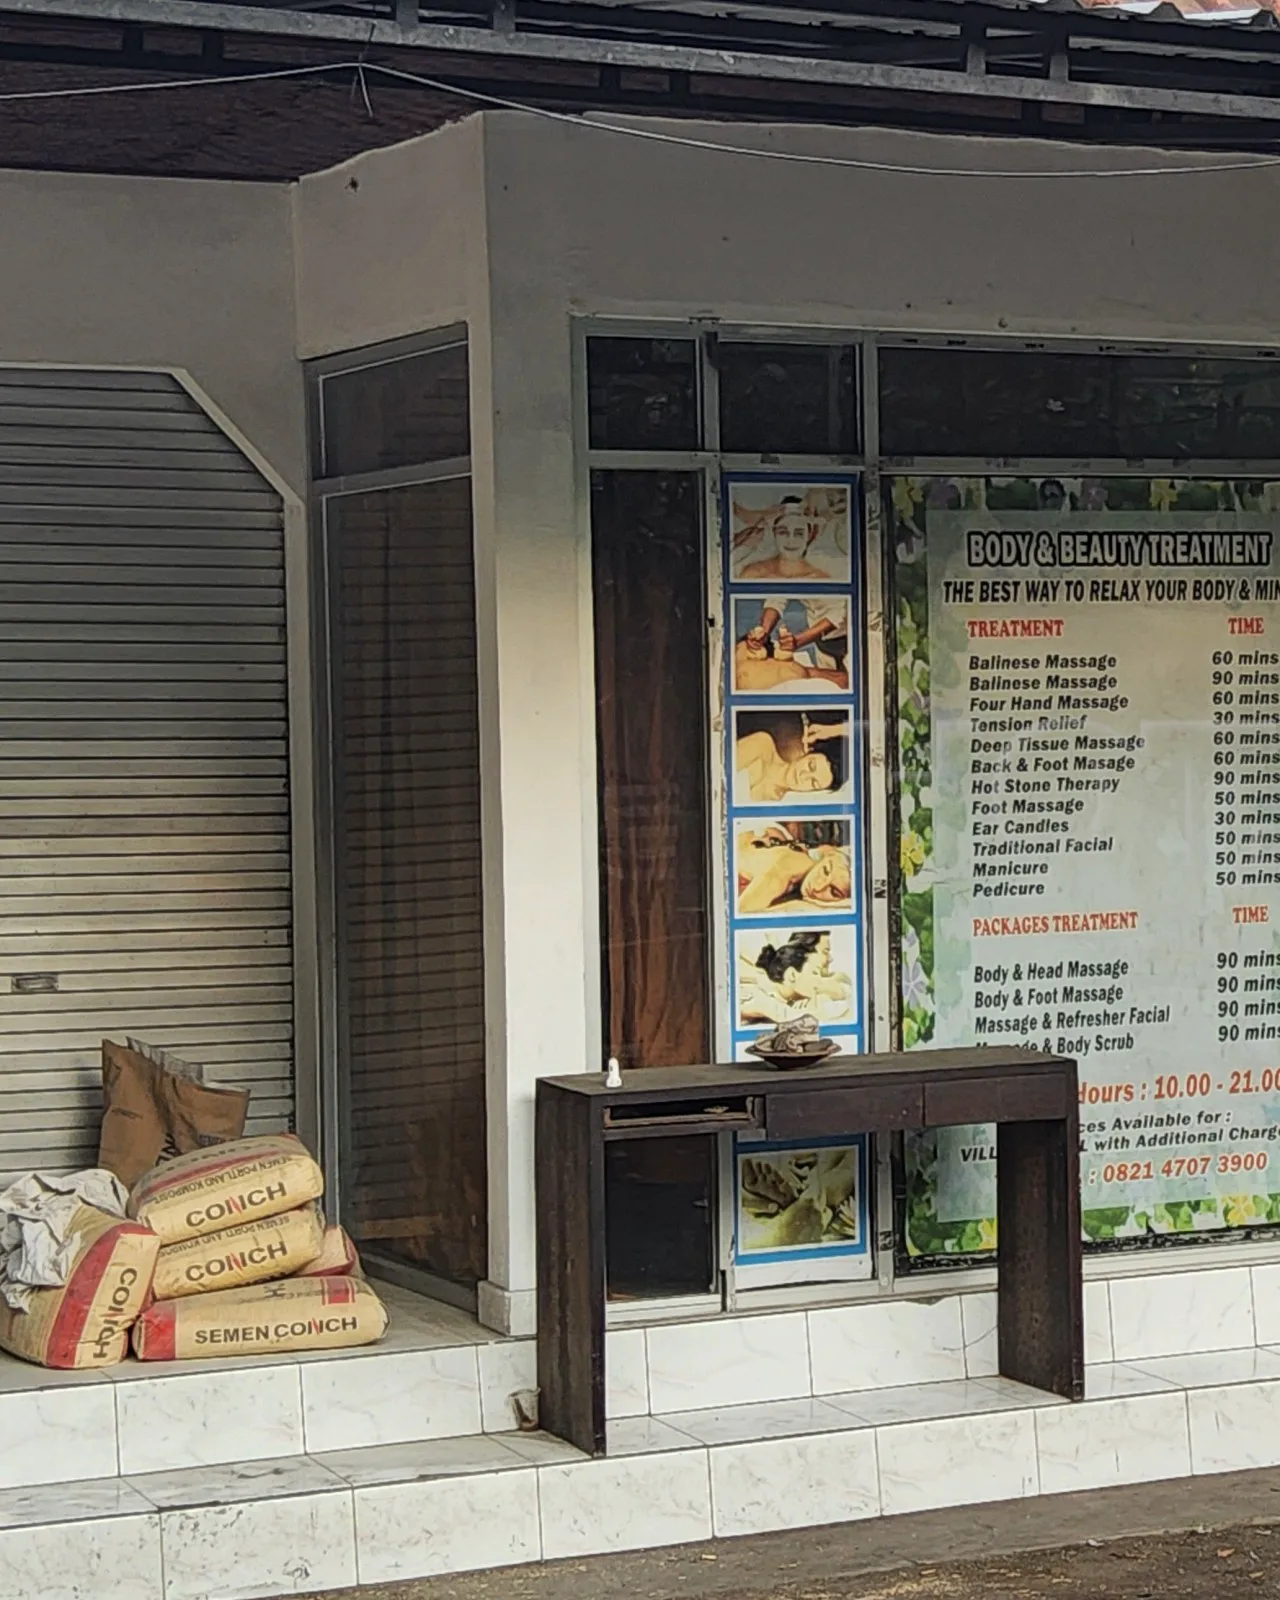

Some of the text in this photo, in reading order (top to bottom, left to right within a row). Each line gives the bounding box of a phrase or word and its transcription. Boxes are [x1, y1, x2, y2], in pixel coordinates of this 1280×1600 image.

[967, 531, 1273, 567] BODY & BEAUTY TREATMENT
[944, 581, 974, 602] THE
[979, 581, 1020, 602] BEST
[1026, 580, 1060, 602] WAY
[1065, 580, 1084, 601] TO
[1089, 580, 1141, 601] RELAX
[1146, 579, 1187, 601] YOUR
[1192, 579, 1235, 600] BODY
[1239, 579, 1250, 600] &
[967, 619, 1064, 637] TREATMENT
[1228, 616, 1264, 635] TIME
[969, 654, 1117, 671] Balinese Massage
[1212, 650, 1280, 665] 60 mins
[969, 674, 1118, 691] Balinese Massage
[1212, 670, 1280, 685] 90 mins
[970, 695, 1129, 712] Four Hand Massage
[1213, 690, 1280, 705] 60 mins
[970, 715, 1088, 732] Tension Relief
[1213, 710, 1280, 725] 30 mins
[970, 735, 1146, 756] Deep Tissue Massage
[1213, 730, 1280, 745] 60 mins
[971, 755, 1136, 774] Back & Foot Masage
[1214, 751, 1235, 765] 60
[971, 777, 1120, 794] Hot Stone Therapy
[1214, 771, 1235, 785] 90
[971, 798, 1084, 815] Foot Massage
[1214, 791, 1235, 805] 50
[1215, 811, 1236, 825] 30
[972, 819, 1069, 836] Ear Candles
[973, 837, 1113, 856] Traditional Facial
[1215, 831, 1236, 845] 50
[1215, 851, 1236, 865] 50
[973, 861, 1049, 877] Manicure
[1216, 871, 1236, 885] 50
[973, 882, 1045, 897] Pedicure
[1233, 906, 1269, 923] TIME
[972, 911, 1138, 936] PACKAGES TREATMENT
[1216, 952, 1238, 969] 90
[974, 959, 1129, 985] Body & Head Massage
[1217, 976, 1238, 993] 90
[974, 985, 1124, 1011] Body & Foot Massage
[1217, 1001, 1239, 1018] 90
[975, 1005, 1170, 1035] Massage & Refresher Facial
[1218, 1025, 1239, 1042] 90
[1057, 1036, 1091, 1056] Body
[1095, 1033, 1134, 1051] Scrub
[1154, 1072, 1211, 1099] 10.00
[1112, 1111, 1191, 1132] Available
[1197, 1110, 1221, 1126] for
[961, 1146, 998, 1163] VILL
[1094, 1135, 1130, 1151] with
[1136, 1129, 1223, 1148] Additional
[1103, 1161, 1154, 1183] 0821
[1161, 1157, 1211, 1178] 4707
[1217, 1152, 1268, 1173] 3900
[186, 1181, 287, 1228] CONCH
[185, 1240, 288, 1282] CONCH
[93, 1267, 138, 1359] CONCH
[194, 1316, 358, 1345] SEMEN CONCH
